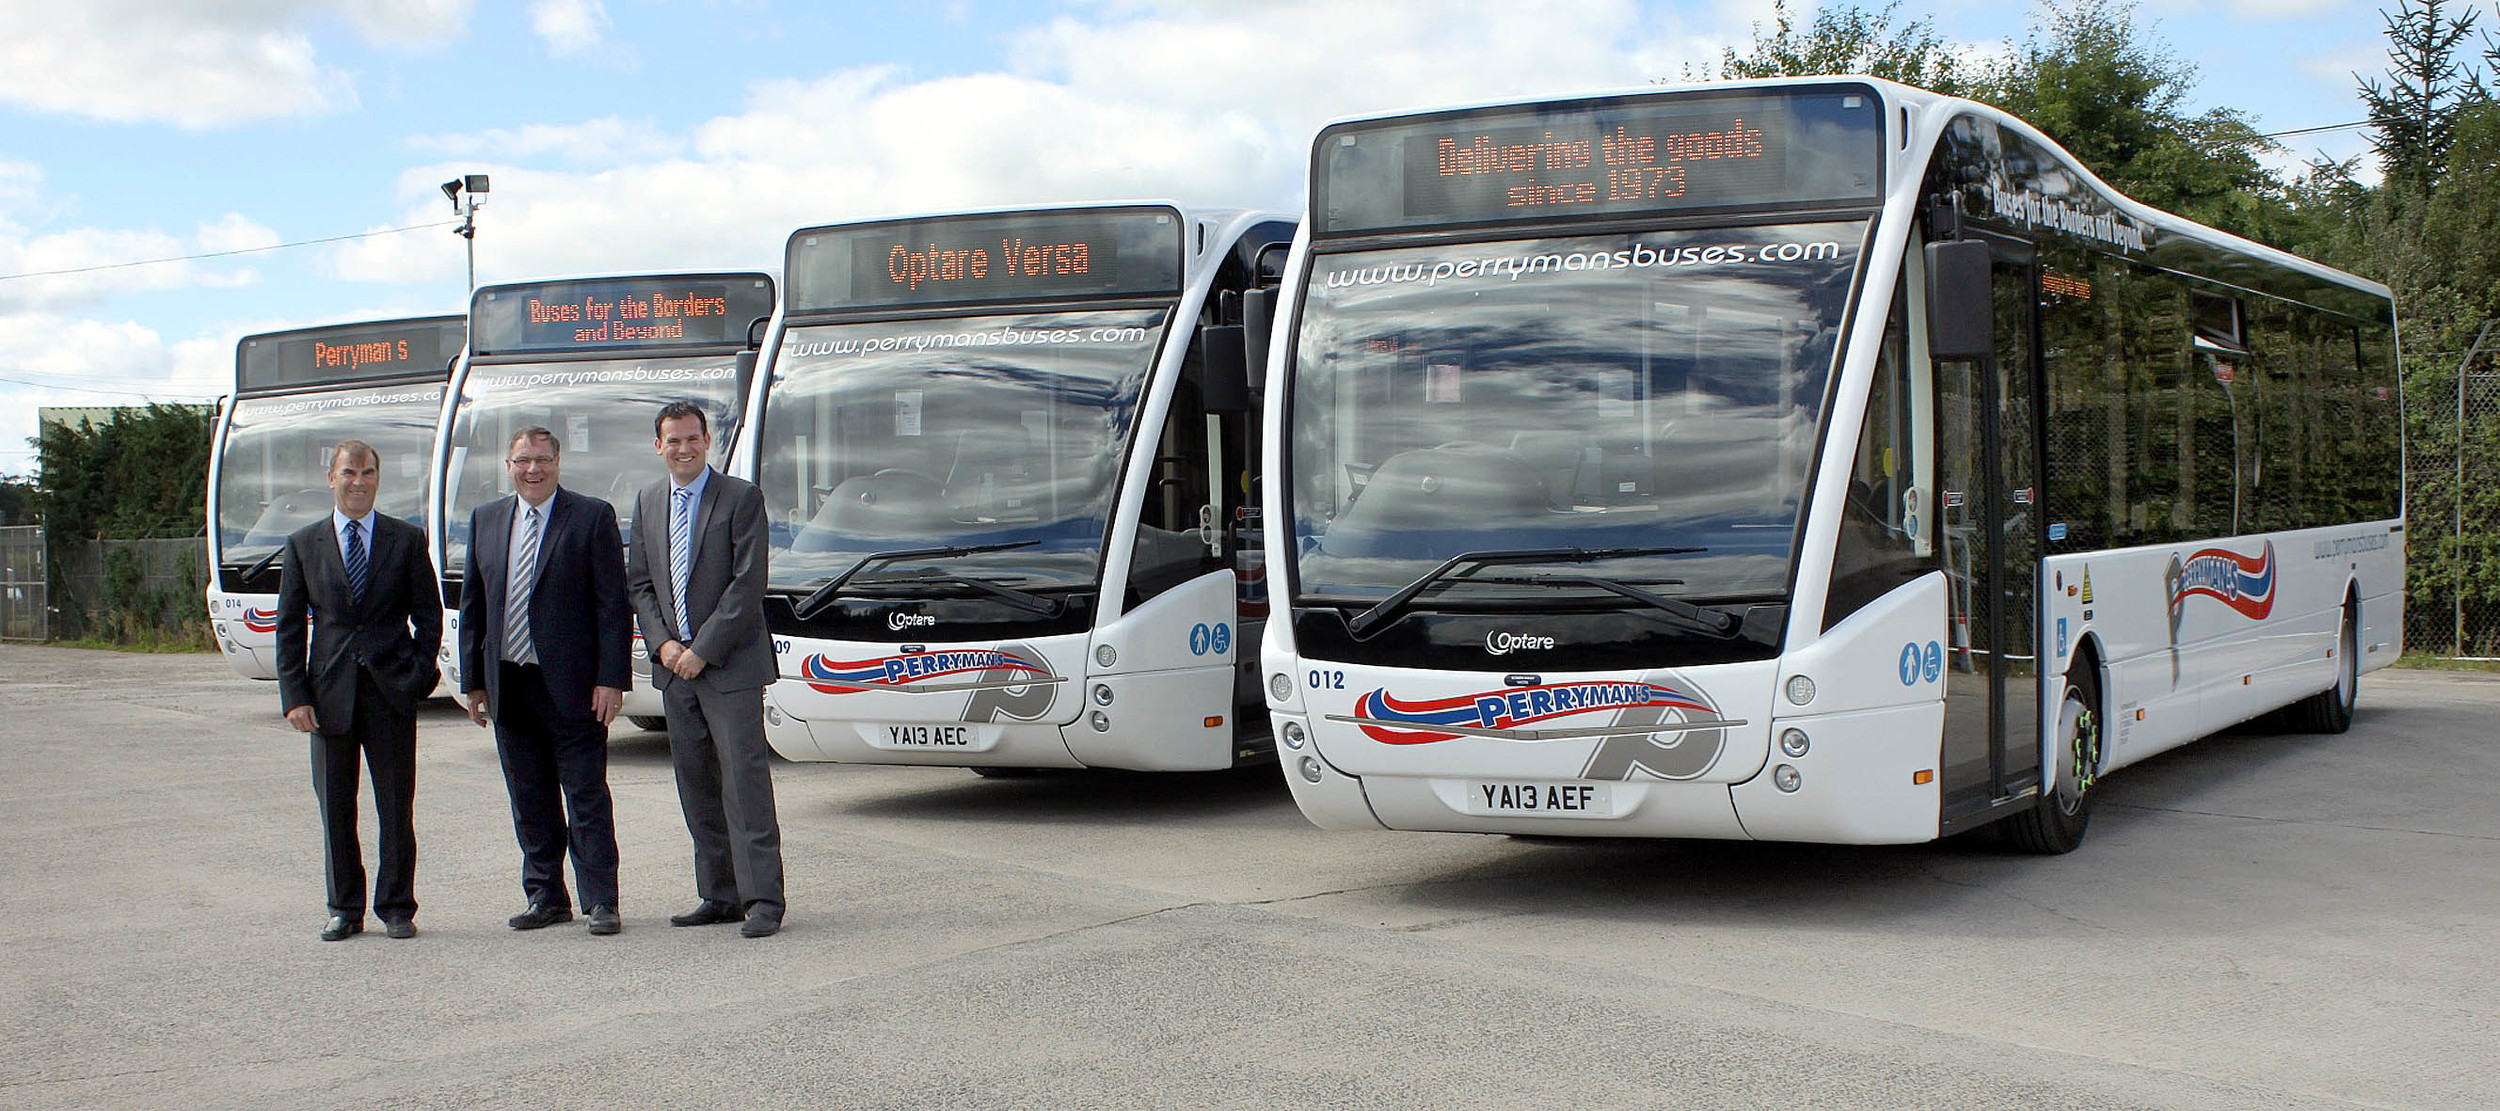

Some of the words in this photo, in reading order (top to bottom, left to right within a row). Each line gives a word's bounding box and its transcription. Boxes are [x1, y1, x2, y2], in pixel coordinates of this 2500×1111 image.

[1438, 130, 1590, 177] Delivering
[1602, 126, 1656, 166] the
[1666, 118, 1763, 162] goods
[1507, 178, 1597, 207] since
[1607, 165, 1686, 202] 1973
[1992, 180, 2025, 220] Buses
[2026, 188, 2041, 231] for
[2042, 195, 2059, 228] the
[2059, 200, 2095, 238] Borders
[888, 244, 988, 291] Optare
[1003, 238, 1090, 277] Versa
[1327, 240, 1839, 288] www.perrymansbuses.com
[530, 298, 580, 323] Buses
[585, 296, 614, 320] for
[619, 295, 650, 319] the
[653, 292, 726, 318] Borders
[574, 322, 609, 342] and
[613, 319, 683, 340] Beyond
[791, 326, 1146, 358] www.perrymansbuses.com
[315, 341, 392, 370] Perryman
[398, 339, 408, 360] s
[242, 390, 441, 418] www.perrymansbuses.co
[225, 599, 242, 608] 014
[897, 613, 935, 629] Optare
[774, 641, 791, 654] 09
[1497, 633, 1555, 654] Optare
[883, 652, 1004, 684] PERRYMAN'S
[1309, 670, 1345, 689] 012
[1475, 683, 1651, 728] PERRYMAN'S
[890, 727, 929, 745] YA13
[933, 727, 967, 745] AEC
[1483, 784, 1539, 810] YA13
[1546, 786, 1594, 810] AEF
